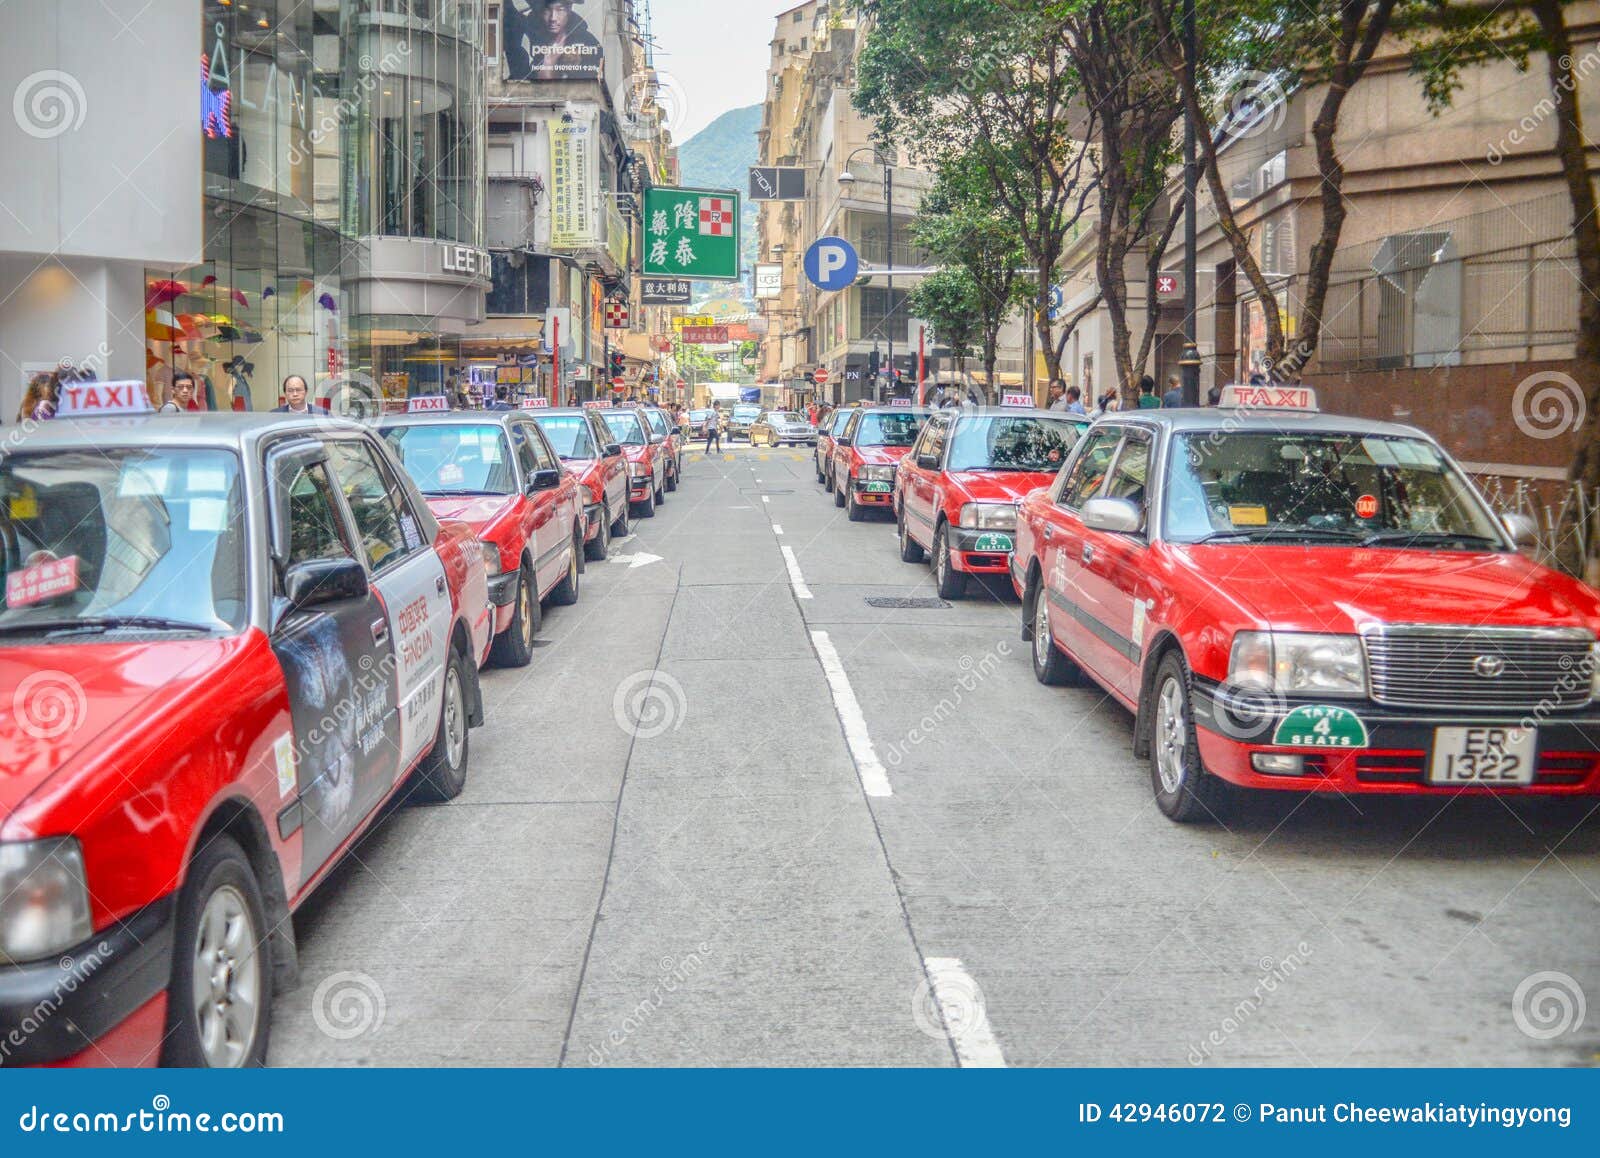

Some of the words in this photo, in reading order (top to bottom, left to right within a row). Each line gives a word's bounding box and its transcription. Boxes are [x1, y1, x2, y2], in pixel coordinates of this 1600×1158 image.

[532, 44, 598, 56] perfectTan
[751, 168, 776, 198] FION
[648, 209, 670, 265] 藥房
[674, 200, 698, 267] 隆泰
[442, 245, 476, 273] LEE
[818, 245, 847, 282] P
[65, 384, 133, 410] TAXI
[411, 398, 444, 410] TAXI
[524, 399, 546, 408] TAXI
[1006, 395, 1033, 405] TAXI
[1234, 387, 1308, 408] TAXI
[1357, 500, 1376, 512] TAXI
[1302, 708, 1345, 720] TAXI
[1313, 717, 1330, 735] 4
[1291, 734, 1351, 746] SEATS
[1466, 728, 1507, 755] ER
[1446, 753, 1521, 780] 1322
